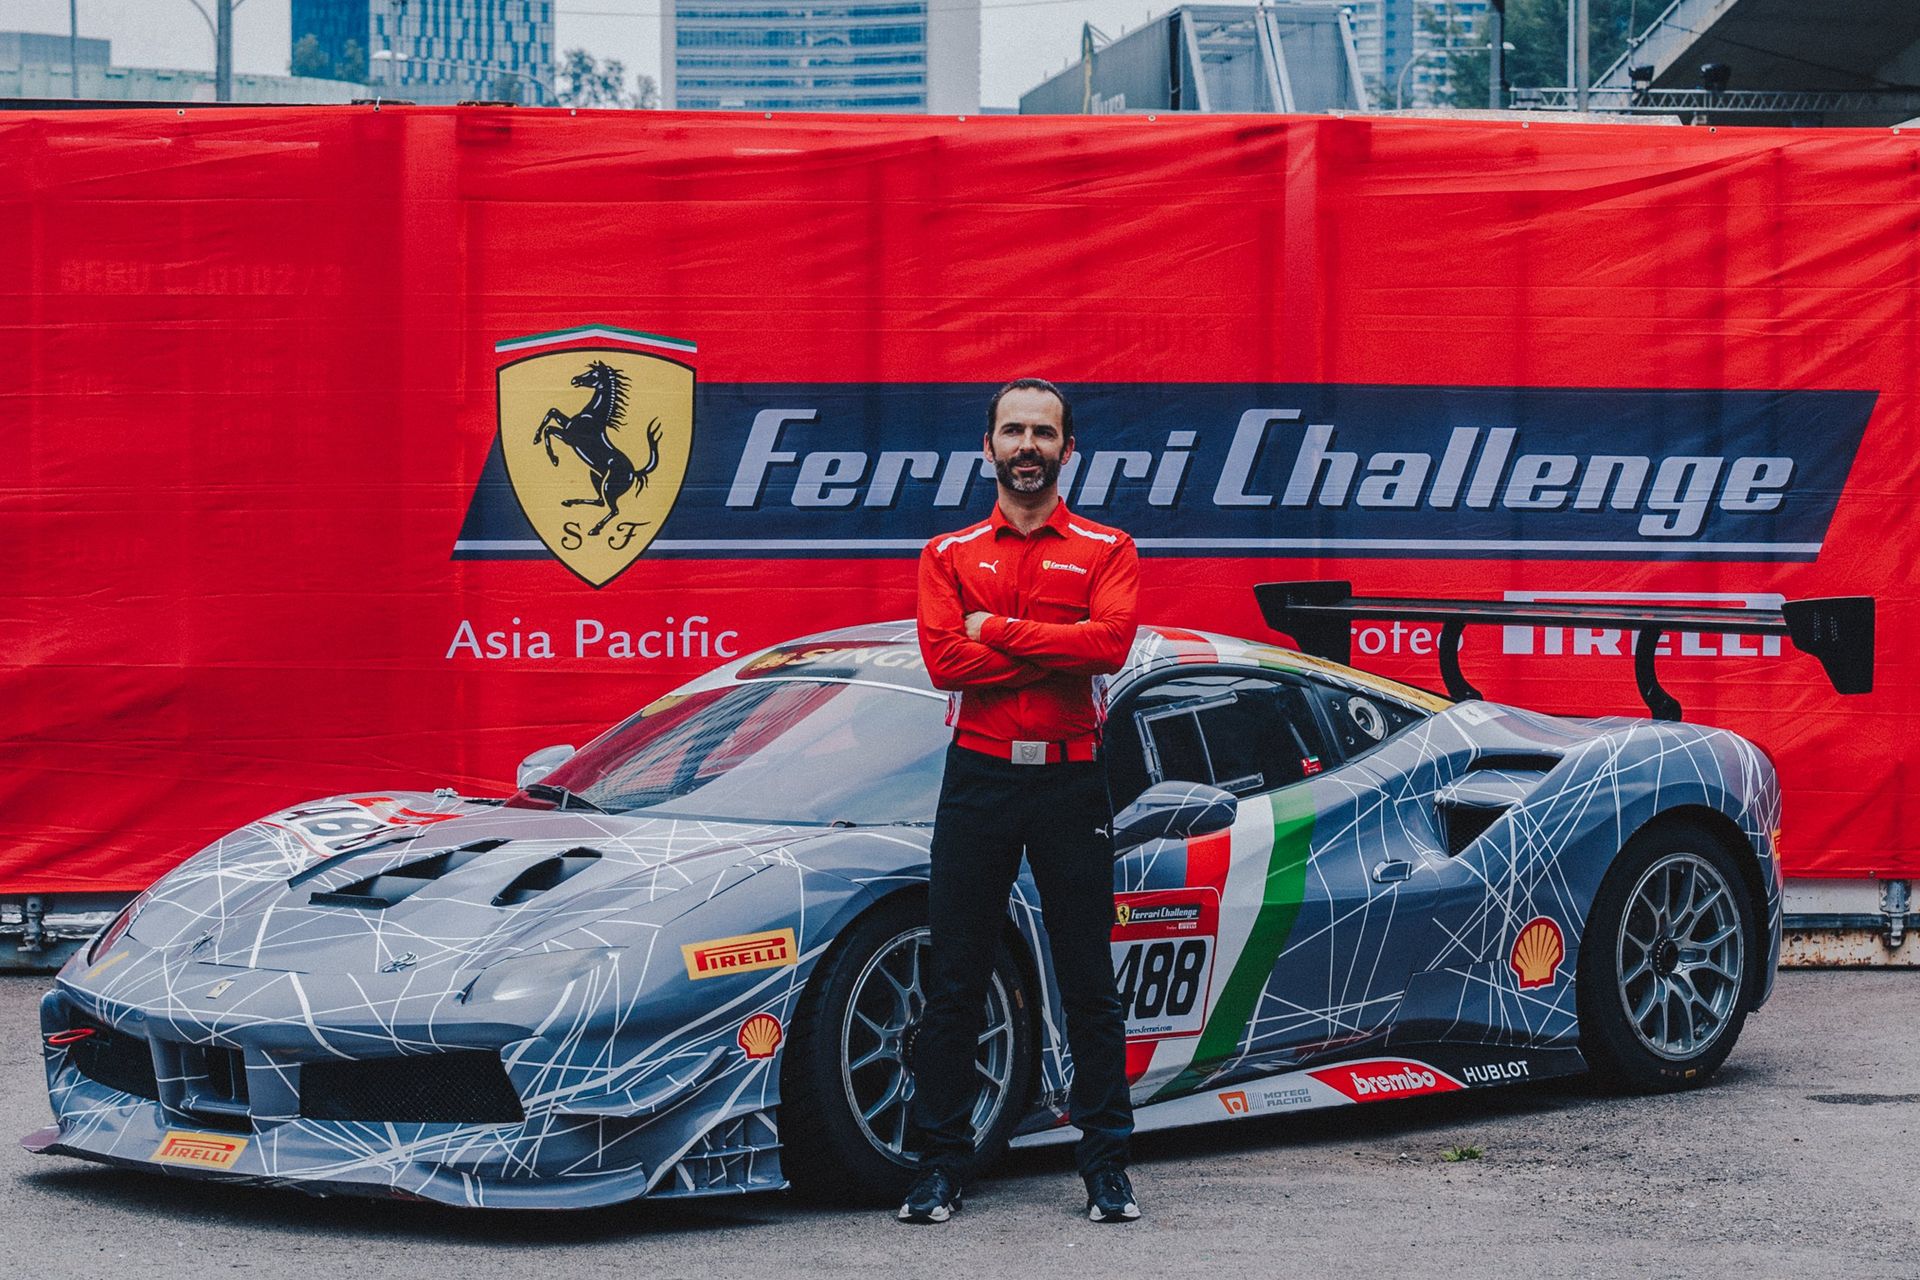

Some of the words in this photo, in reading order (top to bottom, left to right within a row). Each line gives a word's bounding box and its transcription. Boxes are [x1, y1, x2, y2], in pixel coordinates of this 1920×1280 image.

[725, 408, 1198, 507] Ferrri
[1213, 408, 1795, 537] Challenge
[561, 521, 583, 551] S
[445, 617, 555, 660] Asia
[575, 615, 738, 659] Pacific
[1131, 908, 1160, 920] Ferrari
[1160, 906, 1197, 919] Challenge
[694, 937, 787, 972] PIRELLI
[1114, 939, 1206, 1020] 488
[1350, 1066, 1437, 1095] brembo
[1463, 1060, 1530, 1083] HUBLOT
[1263, 1088, 1310, 1100] MOTEGI
[1266, 1095, 1312, 1108] RACING
[161, 1138, 237, 1163] PIRELLI
